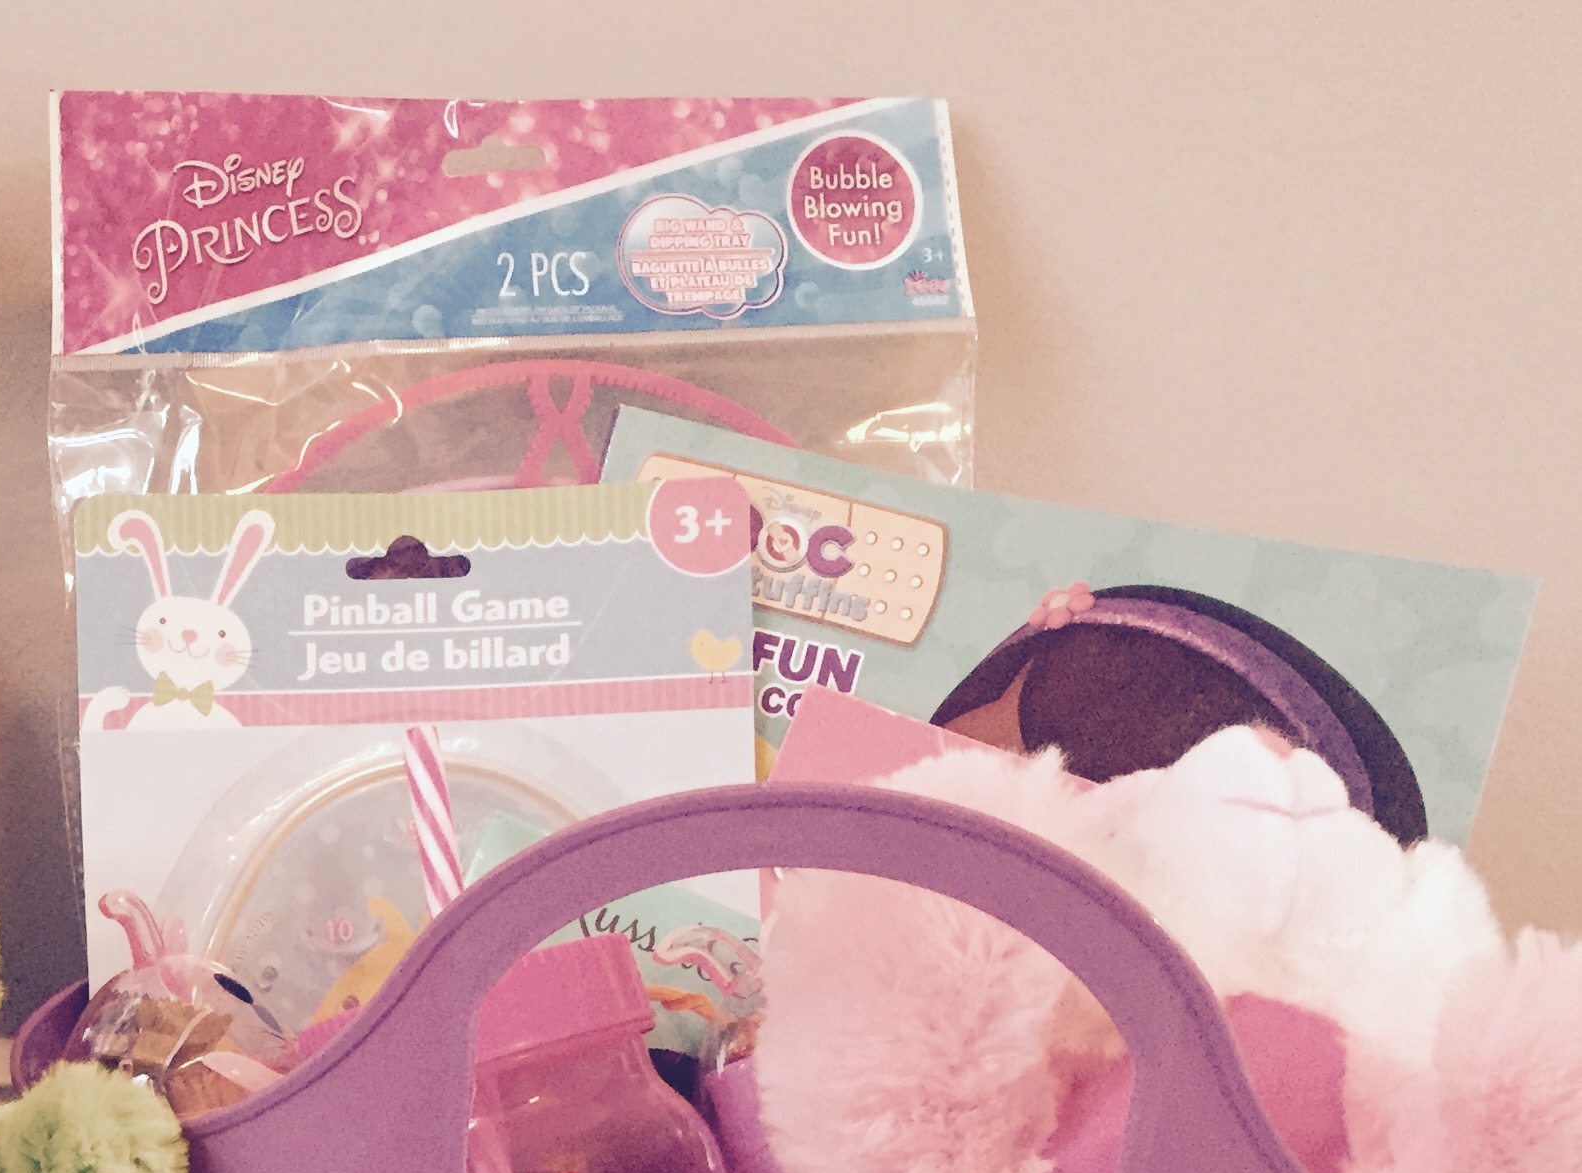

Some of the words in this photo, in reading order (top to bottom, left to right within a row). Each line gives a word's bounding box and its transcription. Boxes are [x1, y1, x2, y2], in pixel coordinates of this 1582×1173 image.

[810, 162, 893, 189] Bubble
[803, 192, 902, 223] Blowing
[828, 223, 881, 246] Fun!
[496, 252, 516, 297] 2
[531, 251, 590, 297] PCS
[674, 505, 732, 543] 3+
[304, 593, 437, 626] Pinball
[451, 590, 570, 623] Game
[297, 642, 367, 681] Jeu
[380, 640, 430, 672] de
[443, 633, 570, 670] billard
[753, 631, 861, 693] FUN
[325, 920, 354, 942] 10
